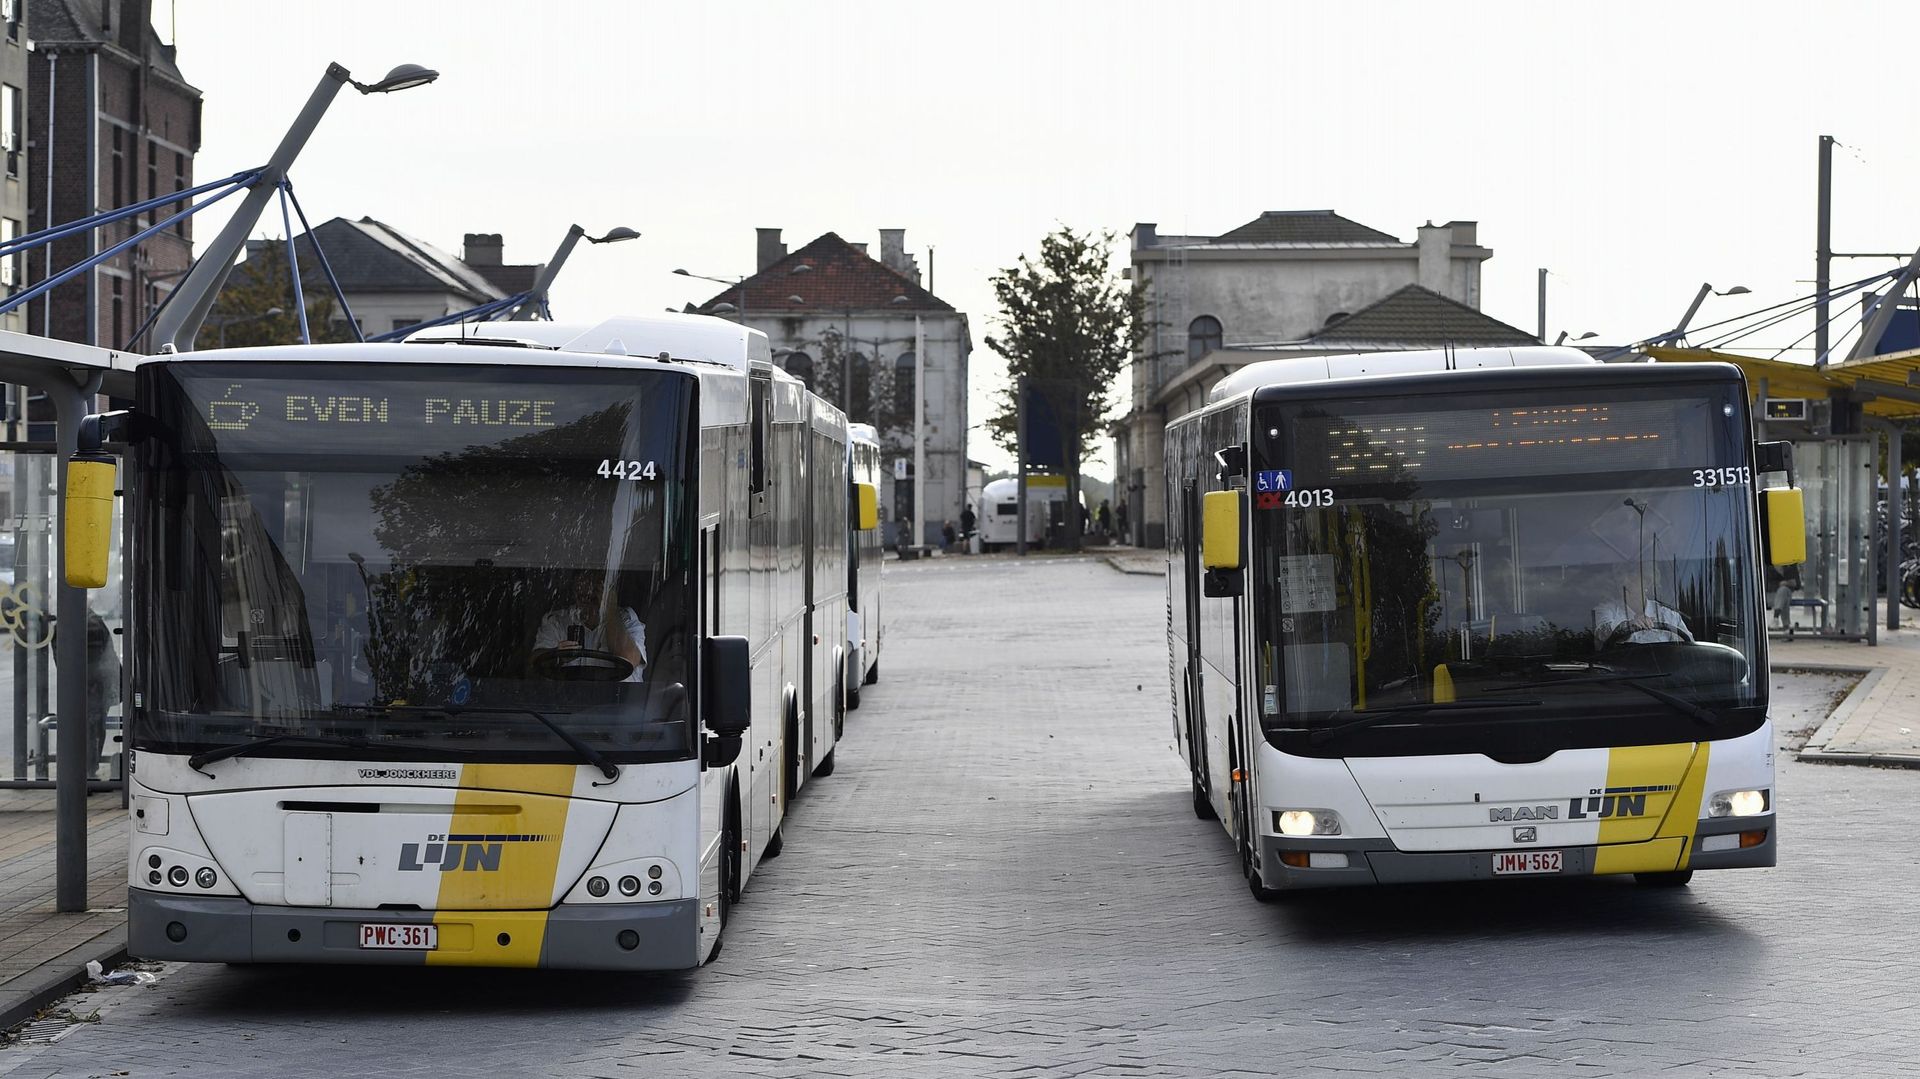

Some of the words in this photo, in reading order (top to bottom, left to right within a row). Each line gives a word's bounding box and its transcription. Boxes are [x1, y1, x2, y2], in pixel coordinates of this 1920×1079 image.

[286, 396, 388, 422] EVEN
[425, 398, 555, 426] PAUZE
[597, 459, 656, 480] 4424
[1692, 466, 1751, 487] 331513
[1284, 488, 1334, 508] 4013
[358, 769, 380, 778] VDL
[383, 769, 456, 779] JONCKHEERE
[1489, 806, 1559, 822] MAN
[1568, 795, 1646, 819] LIJN
[427, 834, 446, 842] DE
[398, 843, 502, 872] LIJN
